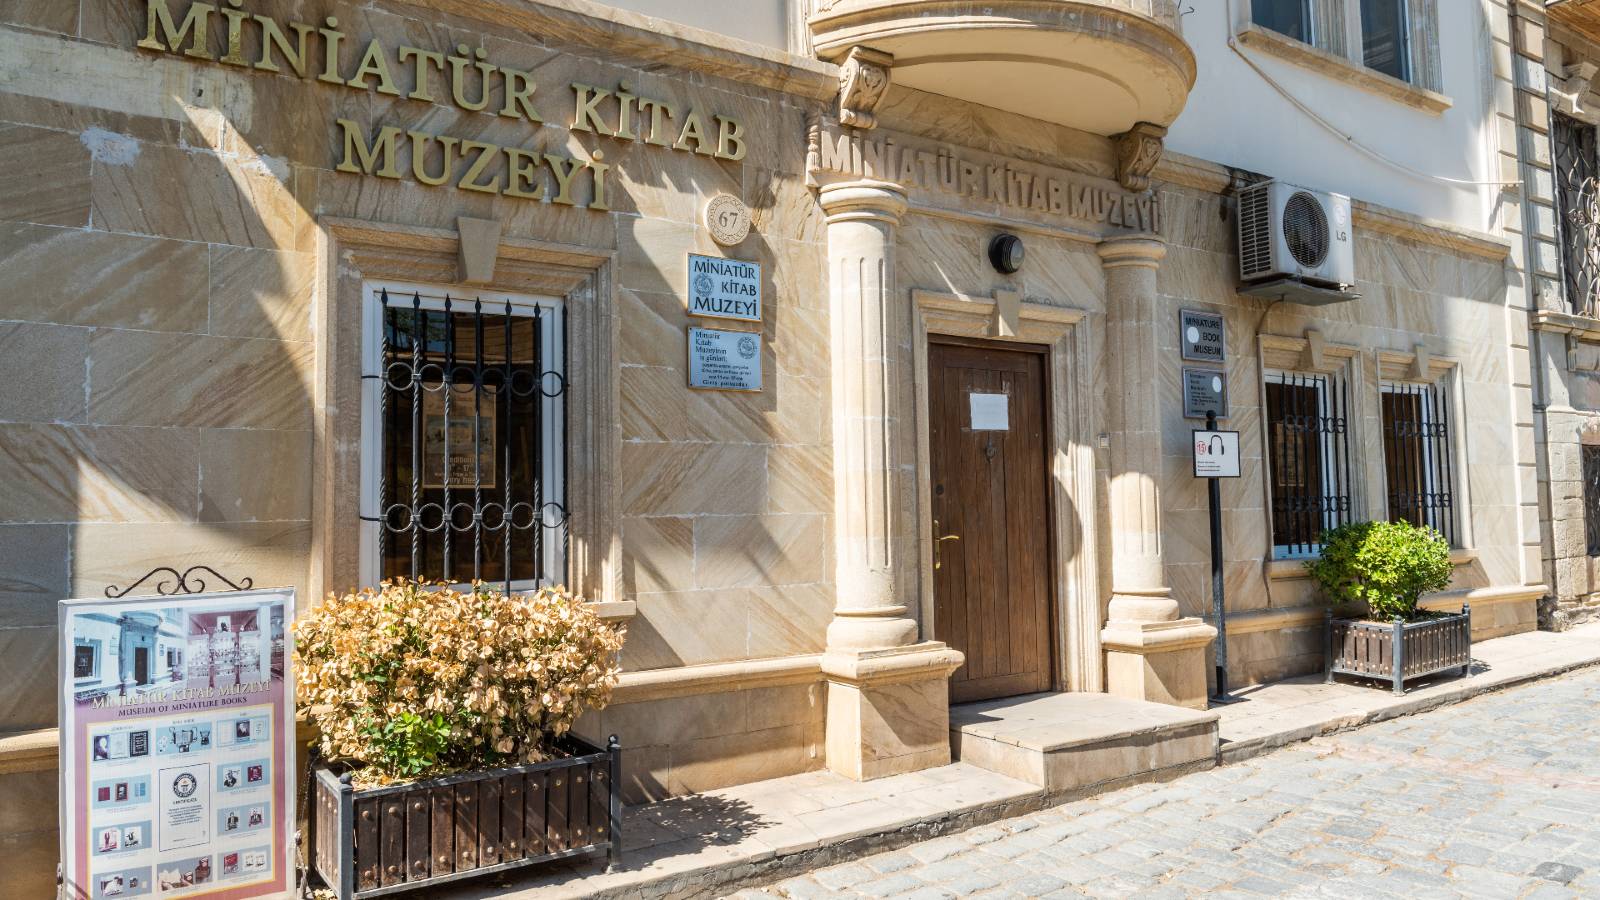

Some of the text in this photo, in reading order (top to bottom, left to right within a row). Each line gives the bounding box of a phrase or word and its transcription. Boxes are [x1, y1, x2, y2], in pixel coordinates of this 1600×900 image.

[137, 0, 748, 161] MİNİATÜR KİTAB
[336, 117, 610, 211] MUZEYİ
[718, 211, 739, 228] 67
[1335, 230, 1347, 242] LG
[694, 259, 756, 279] MİNİATÜR
[721, 280, 757, 296] KİTAB
[694, 296, 757, 316] MUZEYİ
[1185, 317, 1221, 329] MINIATURE
[1202, 332, 1221, 343] BOOK
[1193, 344, 1221, 356] MUSEUM
[118, 696, 249, 717] MUSEUM OF MINIATURE BOOKS
